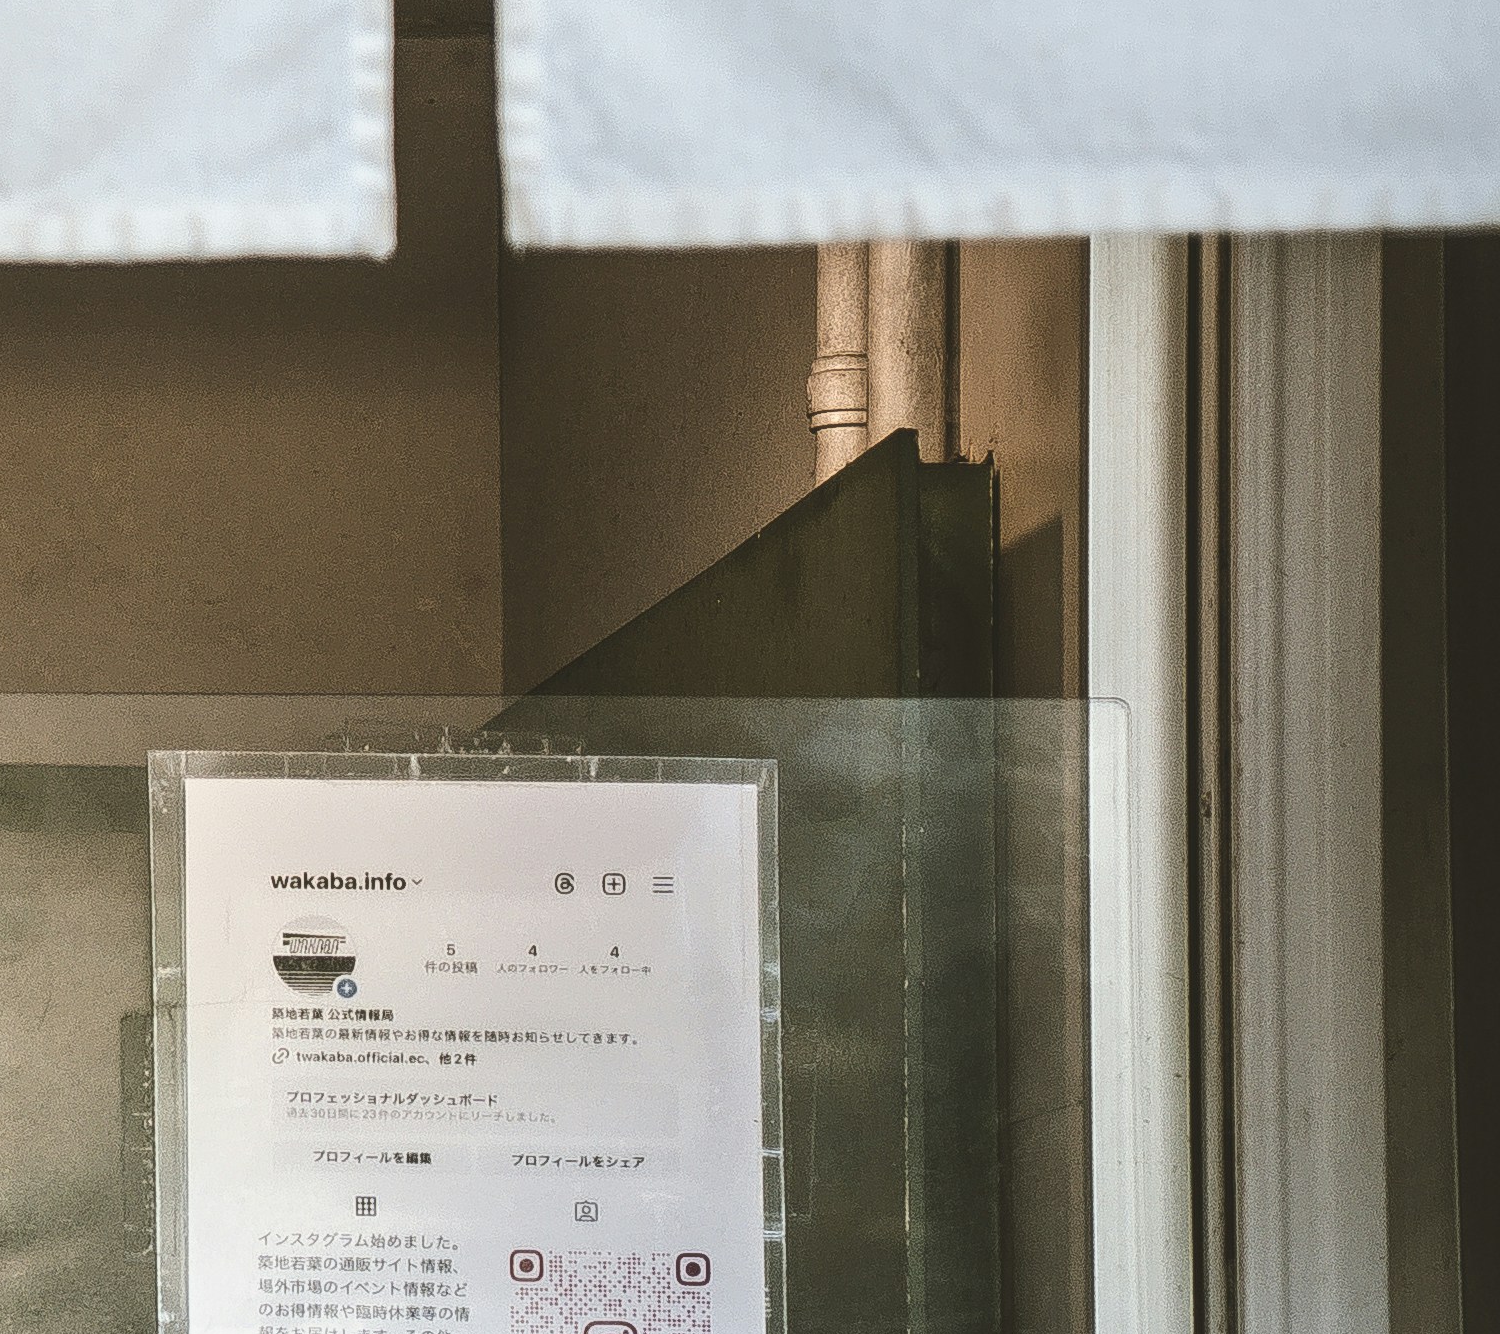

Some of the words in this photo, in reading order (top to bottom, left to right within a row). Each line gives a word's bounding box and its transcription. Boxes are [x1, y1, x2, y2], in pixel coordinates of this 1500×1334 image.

[270, 872, 408, 892] wakaba.info
[446, 943, 456, 957] 5
[528, 944, 538, 957] 4
[609, 945, 620, 959] 4
[424, 961, 478, 975] 件の投稿
[511, 1153, 646, 1169] プロフィールをシェア
[257, 1231, 460, 1251] インスタグラム始めました。
